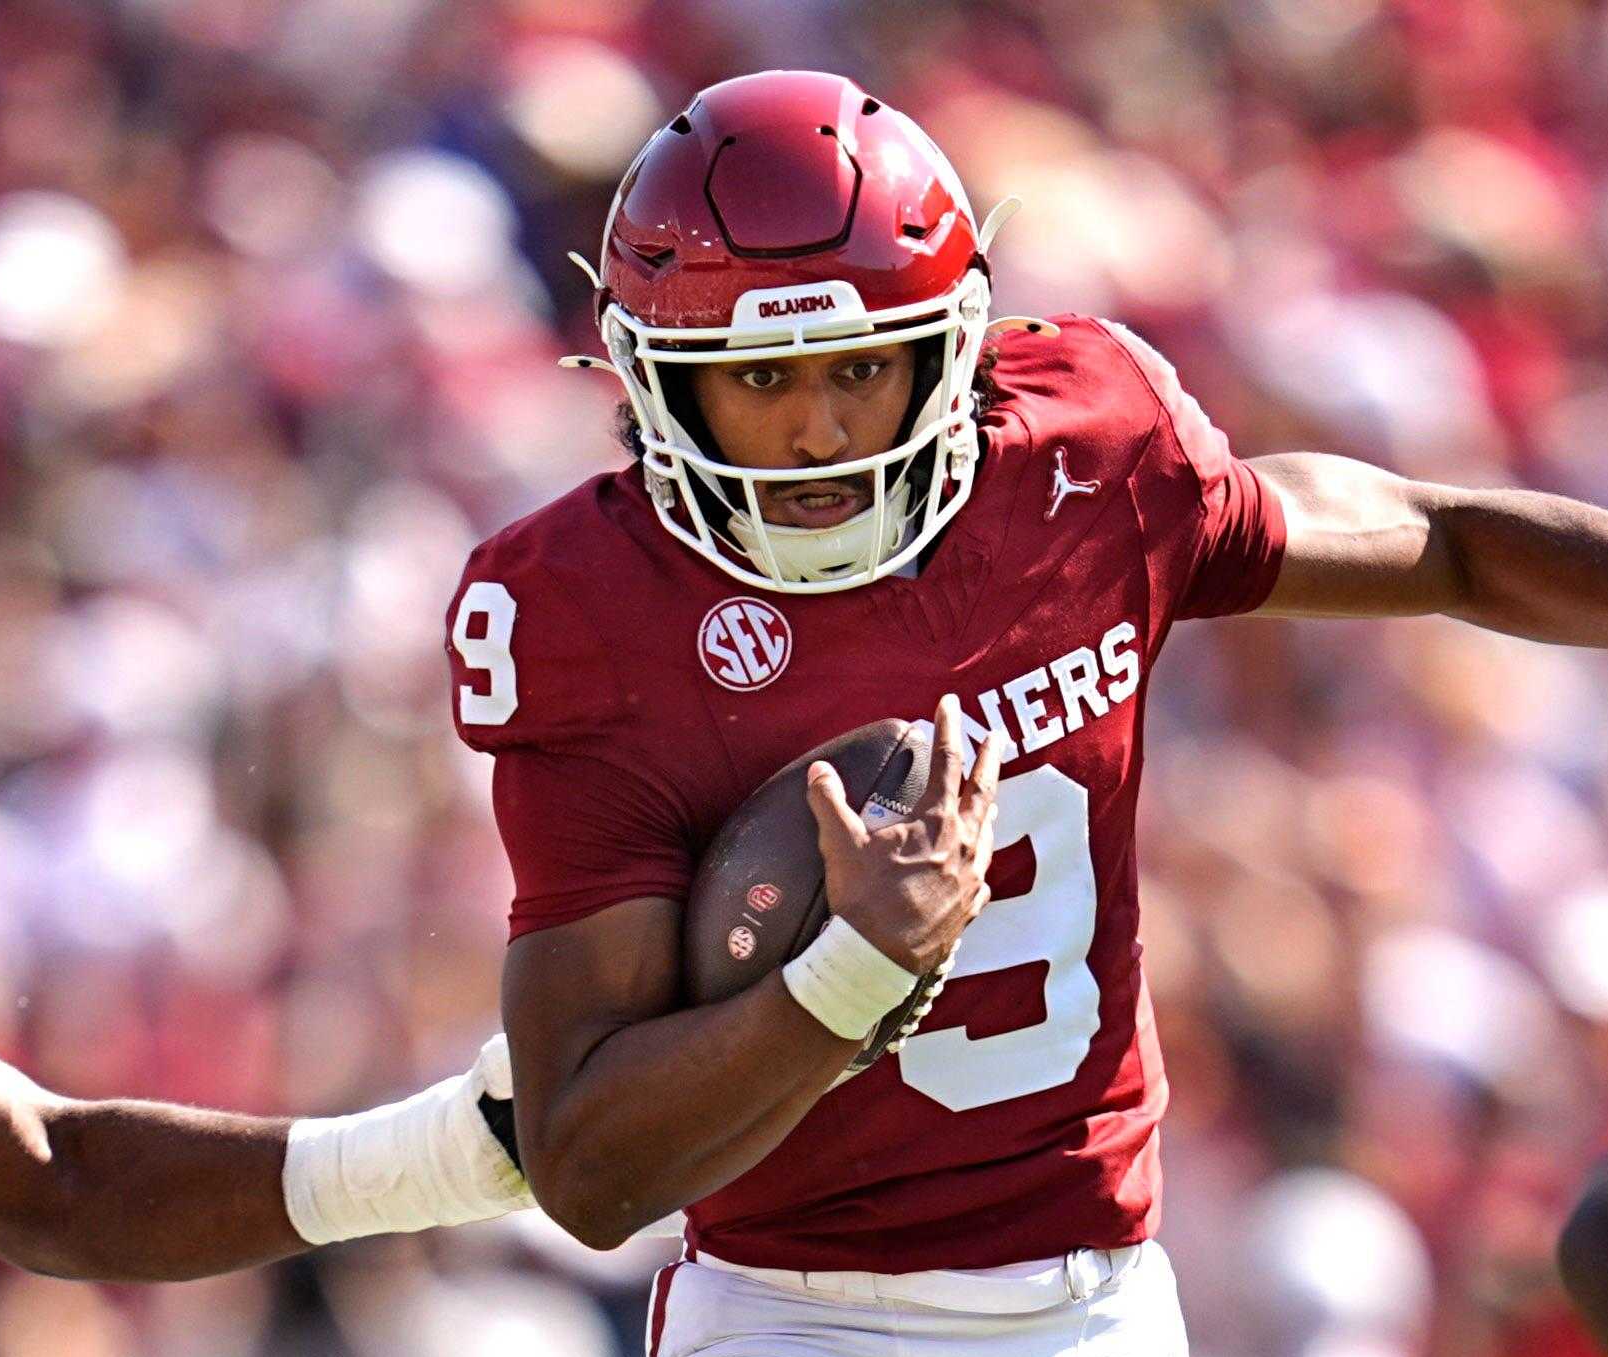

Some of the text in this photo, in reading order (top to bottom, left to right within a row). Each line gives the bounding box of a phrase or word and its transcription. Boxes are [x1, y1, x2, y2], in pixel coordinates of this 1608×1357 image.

[758, 294, 836, 318] OKLAHOMA
[452, 581, 519, 726] 9
[705, 603, 785, 684] SEC
[896, 763, 1100, 1113] 9
